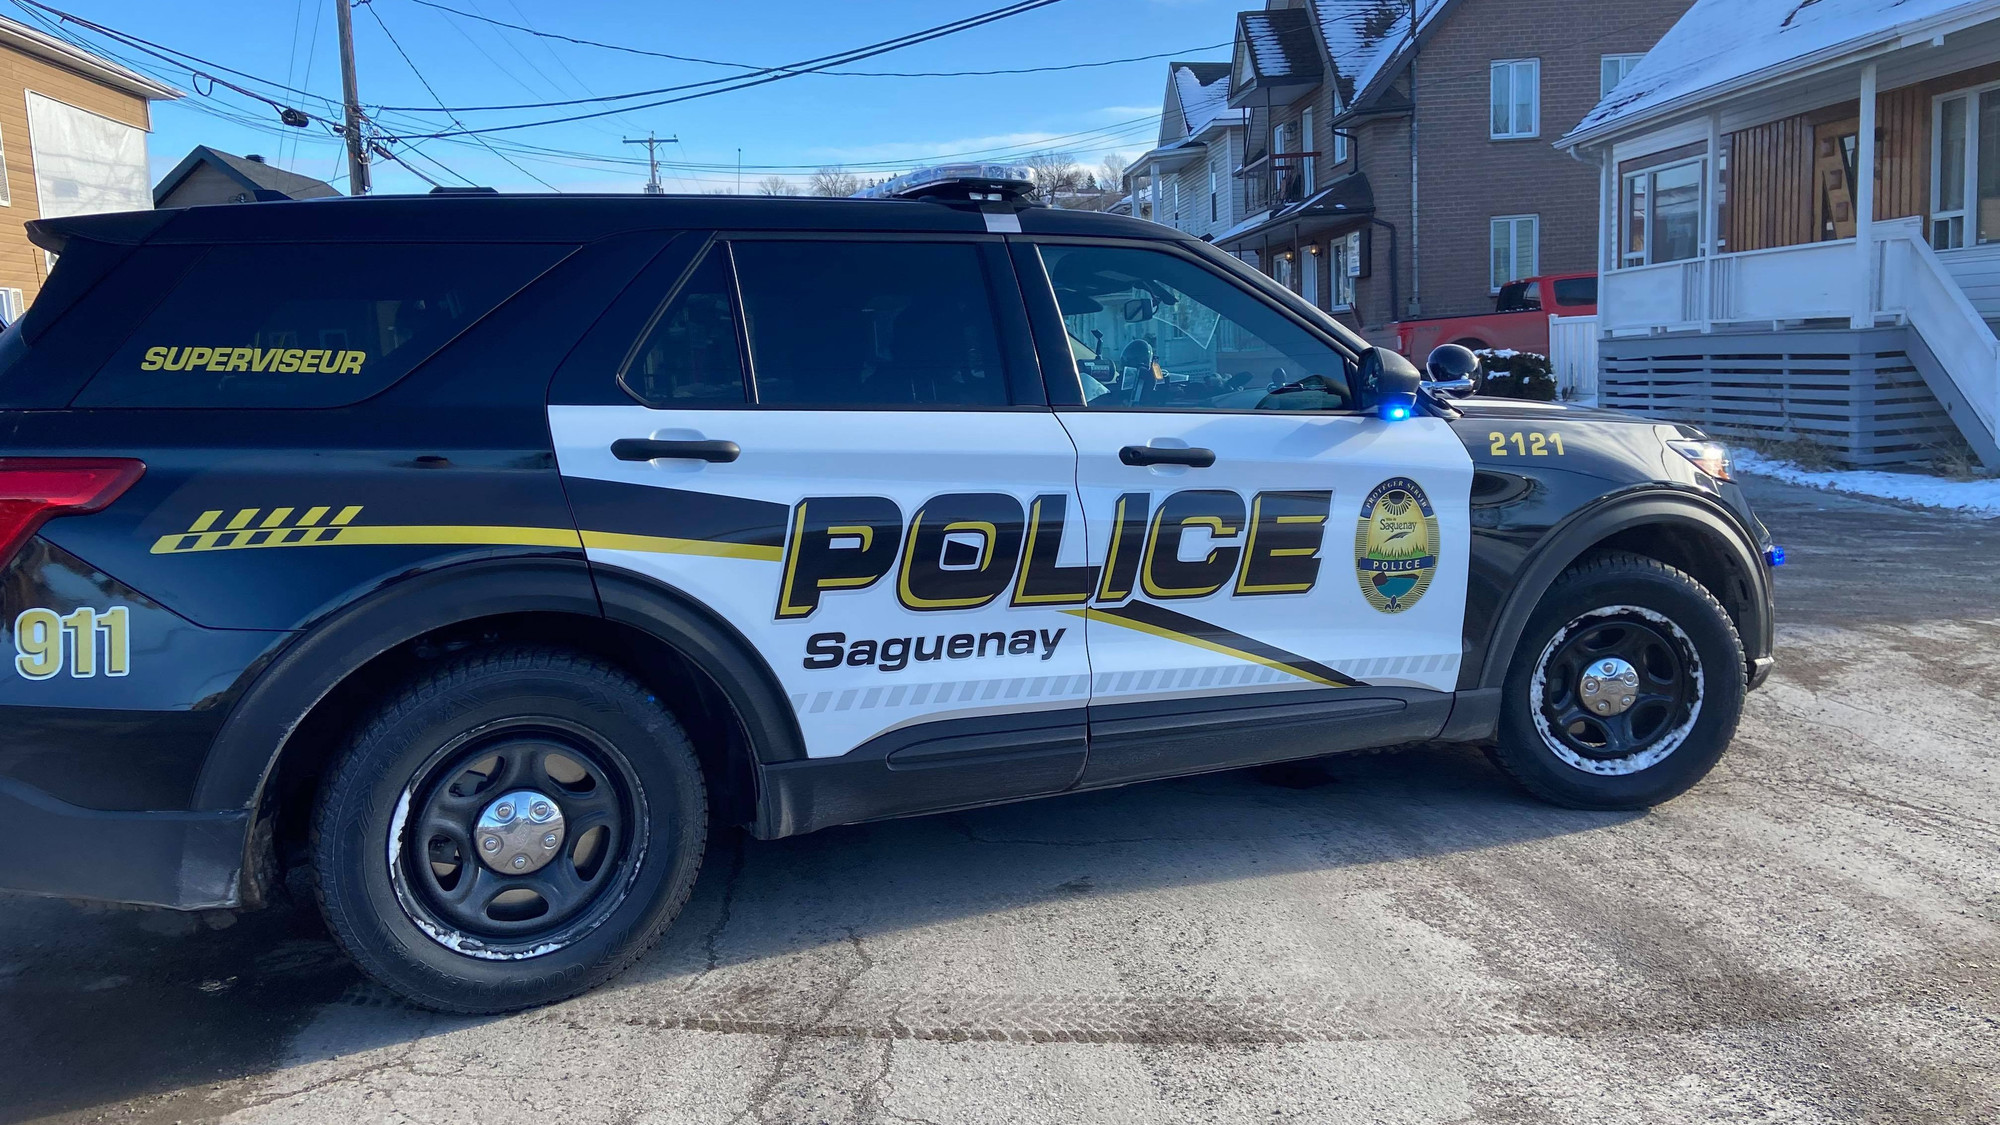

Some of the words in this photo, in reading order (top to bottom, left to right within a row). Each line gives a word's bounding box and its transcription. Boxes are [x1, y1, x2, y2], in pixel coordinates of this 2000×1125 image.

[140, 346, 366, 374] SUPERVISEUR
[1489, 431, 1565, 456] 2121
[1407, 483, 1428, 508] SERVIR
[1379, 518, 1417, 532] Saguenay
[774, 489, 1334, 620] POLICE
[1373, 559, 1421, 571] POLICE
[15, 606, 130, 680] 911
[803, 628, 1067, 671] Saguenay
